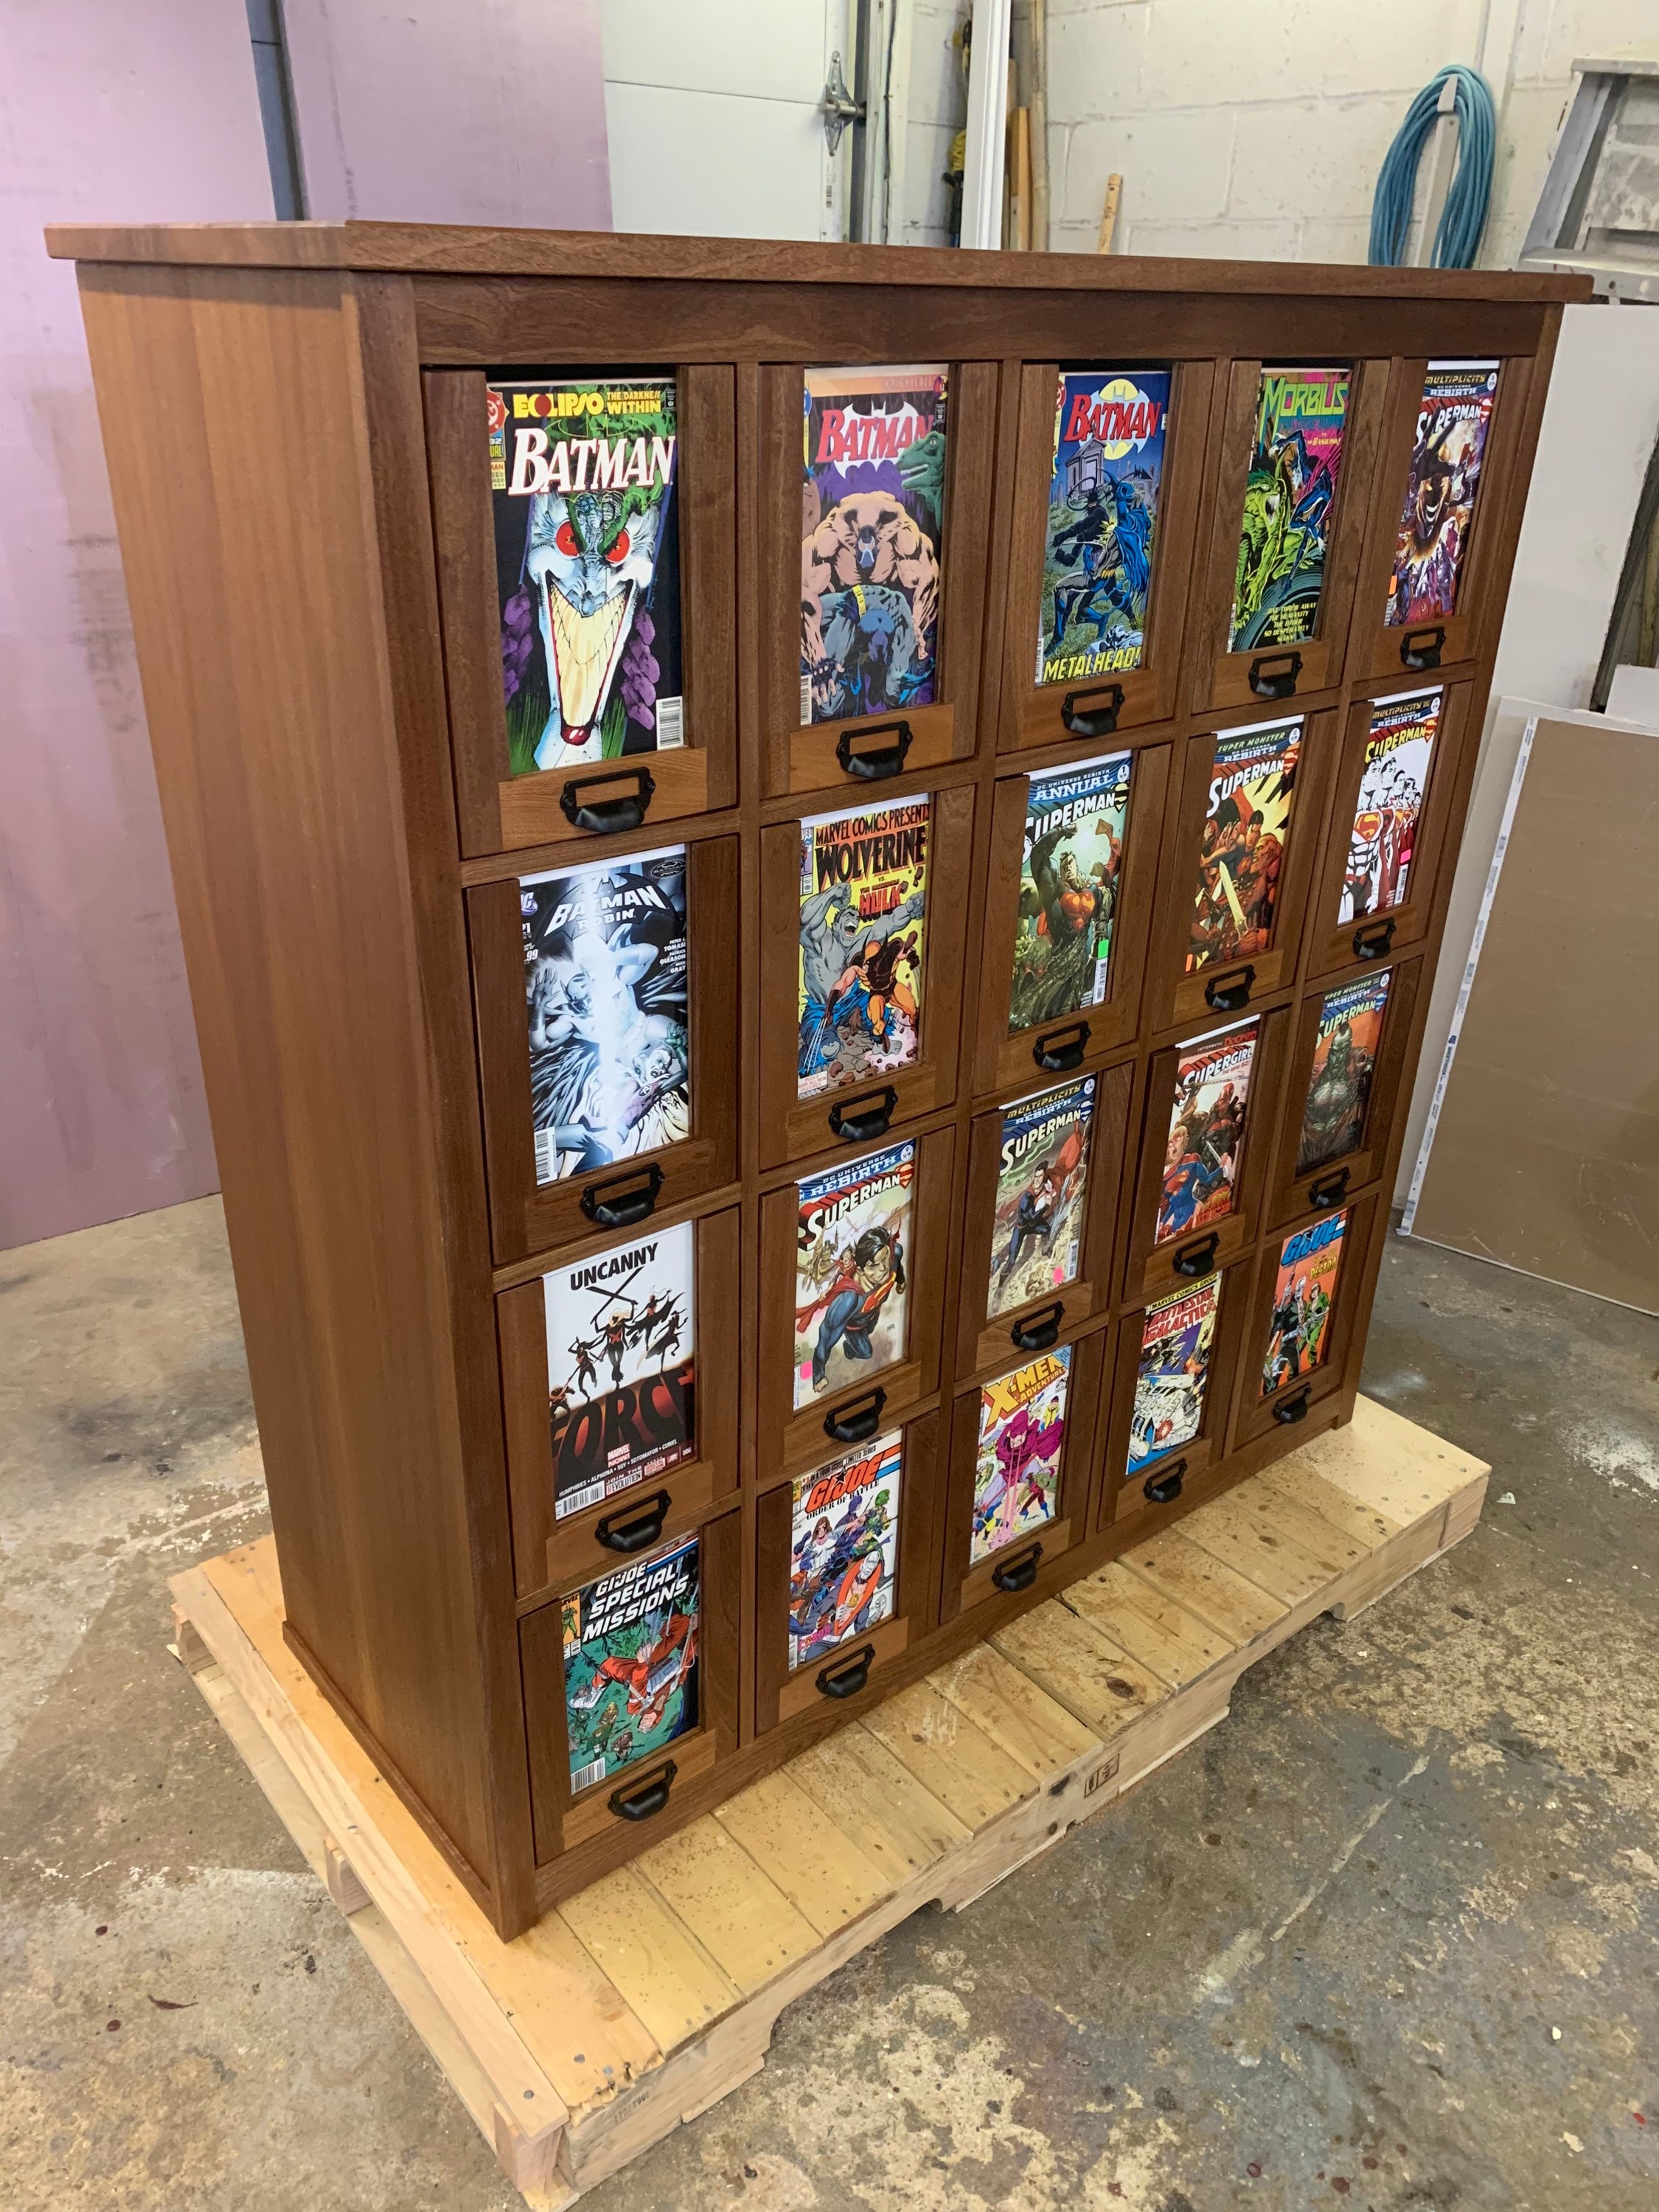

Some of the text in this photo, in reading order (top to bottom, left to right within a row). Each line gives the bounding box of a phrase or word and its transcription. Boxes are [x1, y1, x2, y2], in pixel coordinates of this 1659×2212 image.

[607, 390, 661, 399] THE DARKNESS
[1425, 375, 1486, 384] MULTIPLICITY
[1430, 388, 1477, 397] REBIRTH
[513, 392, 605, 418] ECLIPSO
[607, 400, 661, 414] WITHIN
[1063, 394, 1162, 442] BATMAN
[1259, 377, 1349, 443] MORBIUS
[490, 445, 503, 457] UAL
[815, 408, 934, 463] BATMAN
[507, 427, 676, 496] BATMAN
[1372, 702, 1422, 719] MULTIPLICITY
[1377, 712, 1422, 727] REBIRTH
[1217, 741, 1245, 753] SUPER
[1248, 732, 1286, 747] MONSTER
[1223, 745, 1277, 762] REBIRTH
[1365, 726, 1427, 763] SUPERMAN
[1034, 774, 1113, 801] ANNUAL
[1048, 776, 1081, 788] UNIVERSE
[1083, 769, 1110, 781] REBIRTH
[1206, 759, 1284, 818] SUPERMAN
[801, 828, 813, 840] VEL
[816, 803, 930, 846] MARVEL COMICS PRESENTS
[1022, 793, 1116, 864] SUPERMAN
[815, 824, 928, 894] WOLVERINE
[544, 885, 667, 936] BATMAN
[860, 883, 902, 917] HULK
[659, 953, 686, 965] GLEASON
[664, 942, 686, 952] TOMASI
[669, 964, 686, 974] GRAY
[1325, 990, 1341, 1001] UPER
[1342, 980, 1372, 995] MONSTER
[1326, 989, 1371, 1008] REBIRTH
[1178, 1046, 1253, 1107] SUPERGIRL
[1007, 1085, 1081, 1119] MULTIPLICITY
[1015, 1099, 1072, 1125] REBIRTH
[999, 1110, 1081, 1177] SUPERMAN
[810, 1155, 897, 1197] REBIRTH
[822, 1154, 886, 1185] DC UNIVERSE
[807, 1173, 900, 1251] SUPERMAN
[570, 1242, 658, 1290] UNCANNY
[1149, 1287, 1214, 1329] BATTLESTAR
[1151, 1274, 1218, 1310] MARVEL COMICS GROUP
[1147, 1299, 1218, 1342] GALACTICA
[984, 1354, 1065, 1429] X-MEN
[1019, 1366, 1067, 1403] ADVENTURES
[608, 1443, 630, 1461] MARVEL
[608, 1453, 630, 1467] NOW!
[863, 1445, 877, 1456] SERIES
[559, 1479, 587, 1498] HUMPHRIES
[591, 1468, 613, 1483] ALPHONA
[617, 1462, 627, 1471] SOY
[630, 1447, 658, 1464] SOTOMAYOR
[662, 1439, 678, 1449] CURIEL
[606, 1465, 642, 1485] JOIN THE
[607, 1471, 641, 1495] REVOLUTION
[806, 1479, 879, 1520] ORDER OF BATTLE
[588, 1562, 678, 1621] SPECIAL
[582, 1574, 689, 1644] MISSIONS
